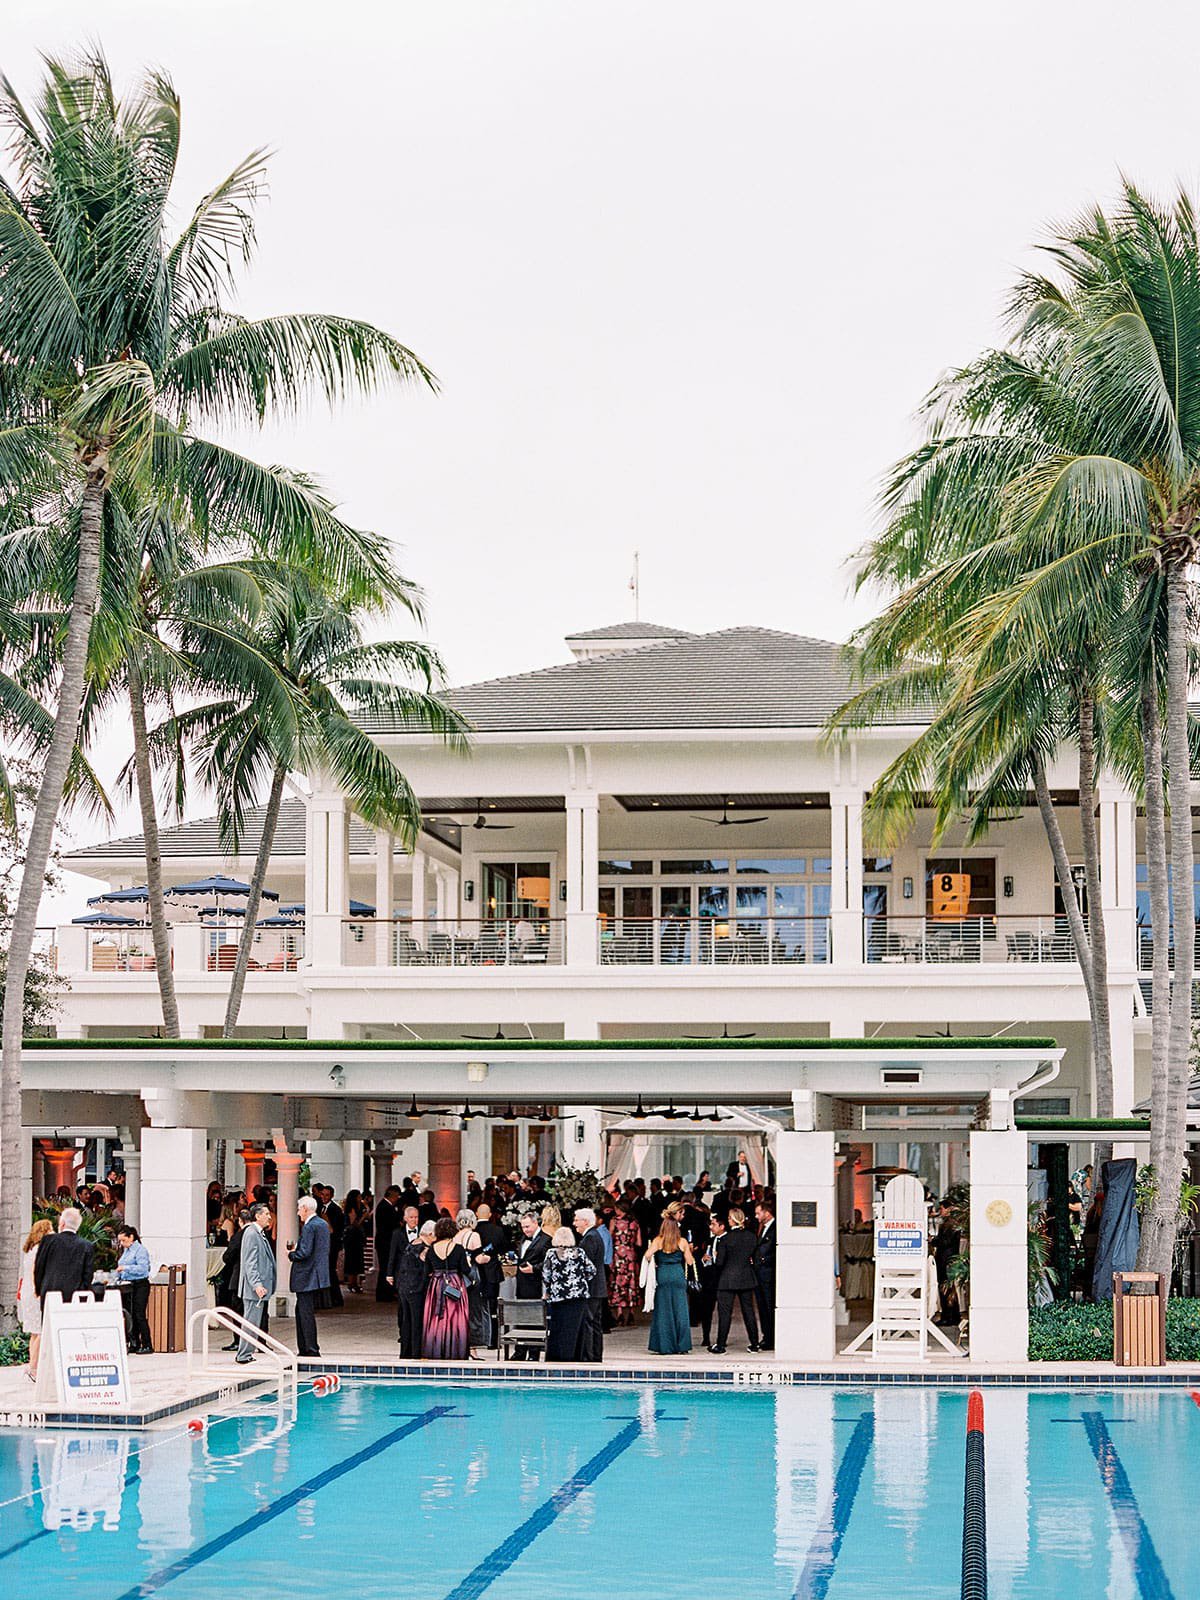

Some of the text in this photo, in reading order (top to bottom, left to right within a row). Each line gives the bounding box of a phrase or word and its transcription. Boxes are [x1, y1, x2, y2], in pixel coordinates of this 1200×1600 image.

[941, 875, 952, 892] 8
[889, 1231, 920, 1239] LIFEGUARD
[75, 1353, 109, 1361] WARNING
[70, 1366, 116, 1377] NO LIFEGUARD
[79, 1376, 108, 1386] ON DUTY
